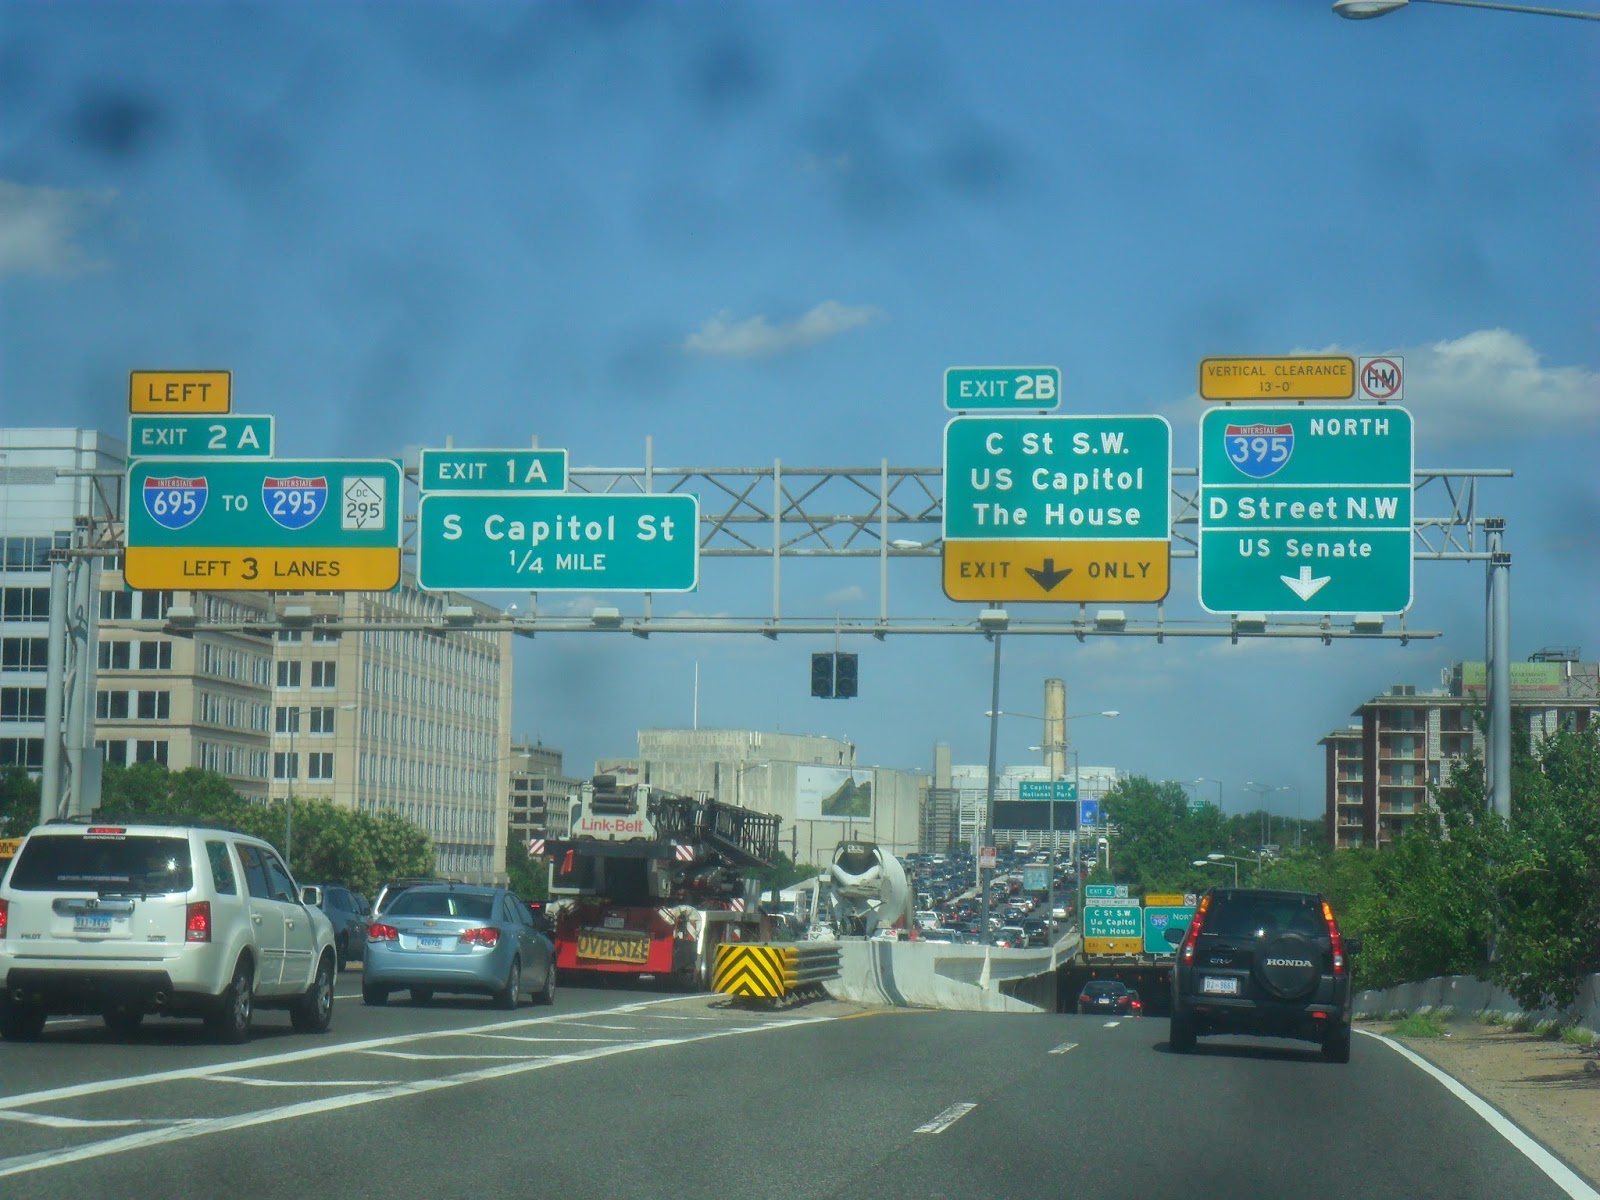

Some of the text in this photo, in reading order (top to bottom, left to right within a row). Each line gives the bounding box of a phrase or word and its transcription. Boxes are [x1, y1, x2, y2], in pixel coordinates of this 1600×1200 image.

[1208, 365, 1347, 376] VERTICAL CLEARANCE
[1367, 369, 1395, 388] HM
[148, 383, 212, 402] LEFT
[960, 375, 1056, 400] EXIT 2B
[142, 428, 188, 445] EXIT
[1310, 418, 1389, 436] NORTH
[986, 432, 1130, 455] C St S.W.
[1232, 437, 1288, 462] 395
[438, 462, 488, 480] EXIT
[971, 467, 1144, 496] US Capitol
[272, 490, 316, 515] 295
[356, 488, 368, 498] DC
[154, 490, 196, 516] 695
[222, 495, 248, 512] TO
[346, 502, 380, 519] 295
[1210, 497, 1228, 519] D
[1238, 496, 1338, 520] Street
[972, 504, 1141, 526] The House
[442, 514, 675, 547] S Capitol St
[1239, 538, 1372, 558] US Senate
[183, 557, 340, 580] LEFT 3 LANES
[509, 550, 606, 574] 1/4 MILE
[960, 562, 1151, 578] EXIT ONLY
[581, 818, 643, 832] Link-Belt
[1106, 918, 1136, 926] Capitol
[20, 932, 42, 940] PILOT
[578, 936, 649, 959] OVERSIZE
[1266, 958, 1314, 968] HONDA
